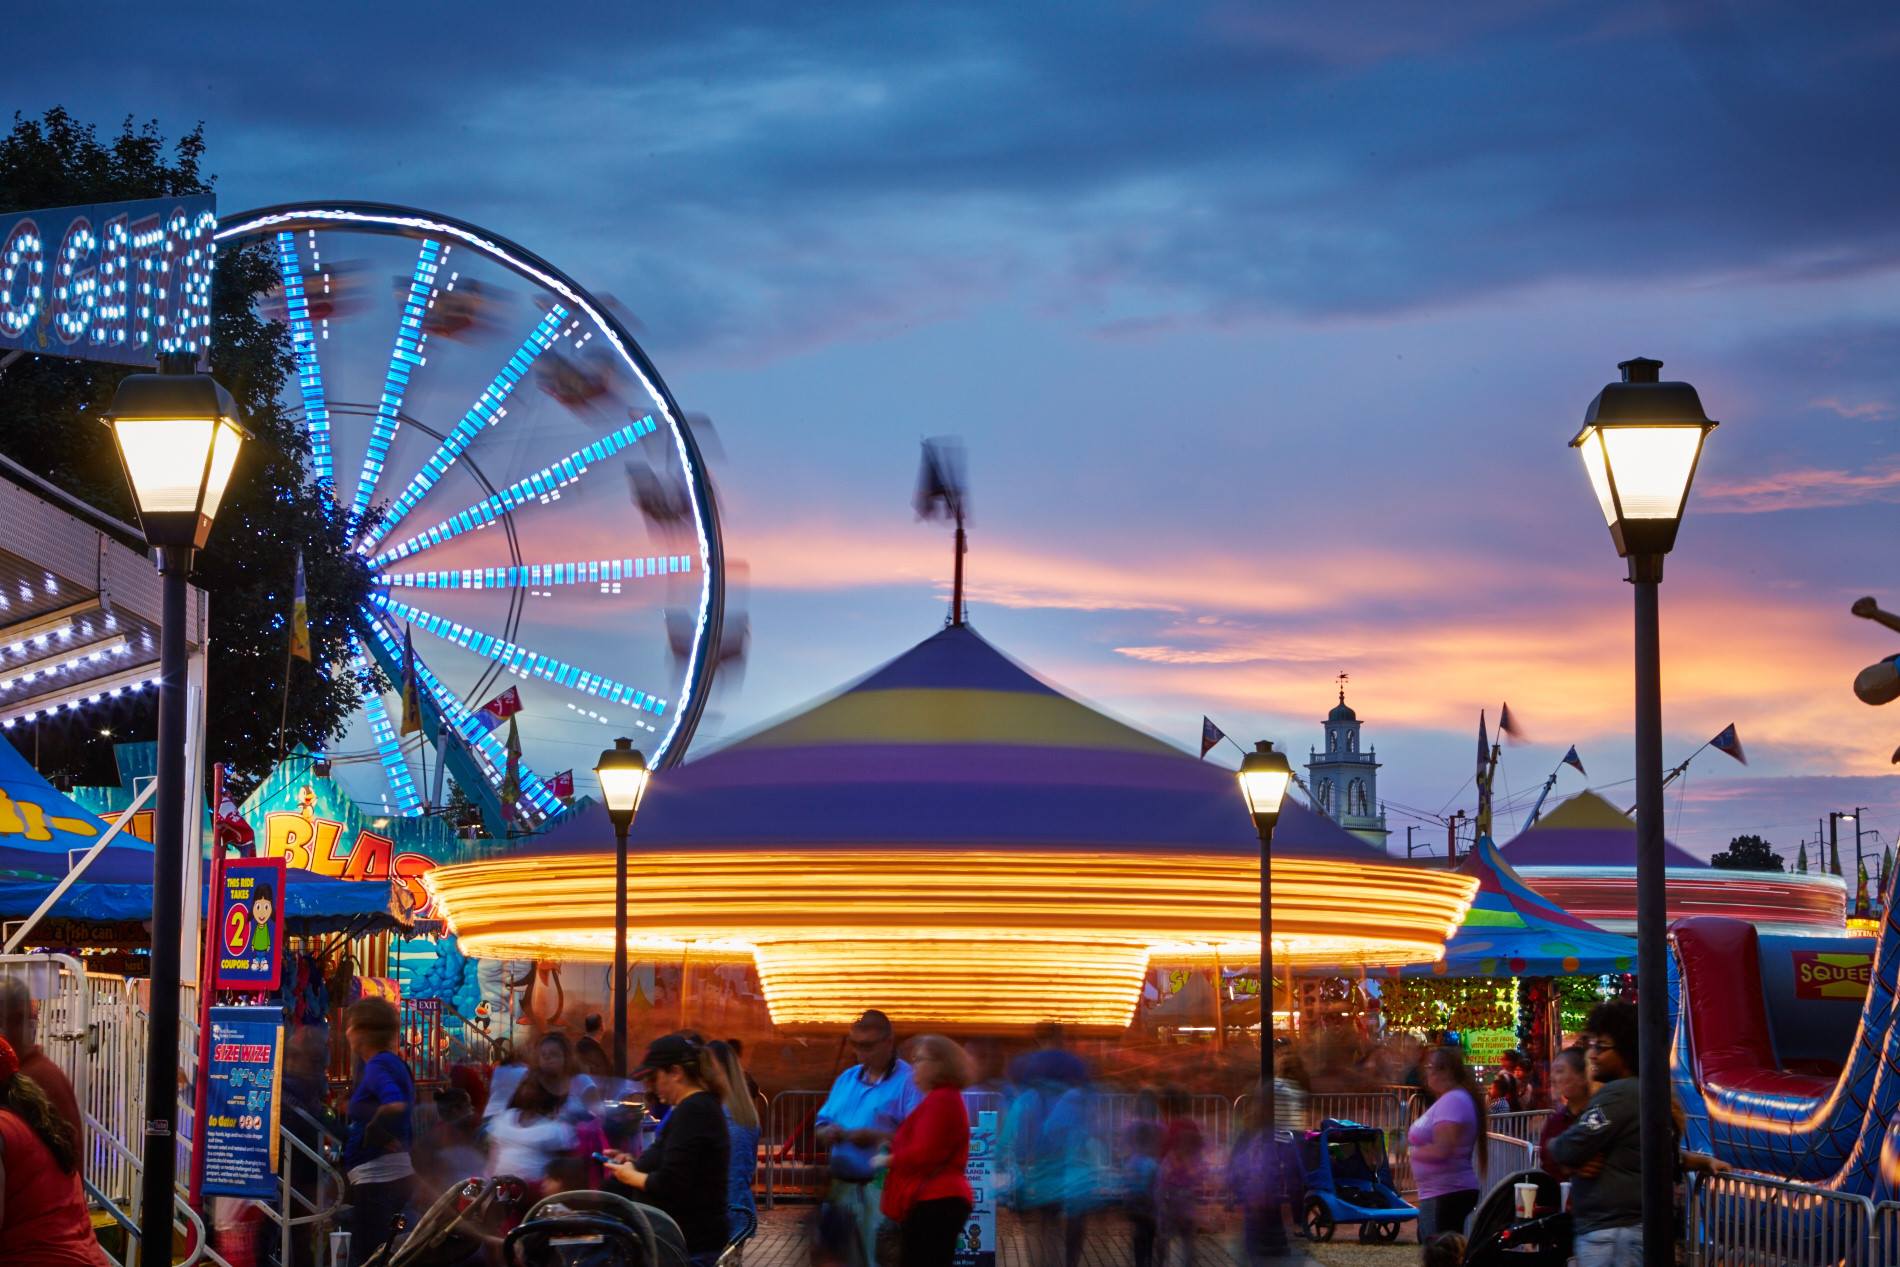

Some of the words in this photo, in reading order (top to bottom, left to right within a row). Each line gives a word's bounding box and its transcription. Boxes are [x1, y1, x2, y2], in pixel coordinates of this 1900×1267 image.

[266, 812, 442, 920] BLAS
[227, 878, 239, 887] THIS
[241, 878, 255, 887] RIDE
[231, 889, 249, 899] TAKES
[230, 911, 245, 947] 2
[221, 959, 249, 970] COUPONS
[419, 1001, 437, 1010] EXIT
[214, 1043, 240, 1062] SIZE
[240, 1044, 271, 1063] WIZE
